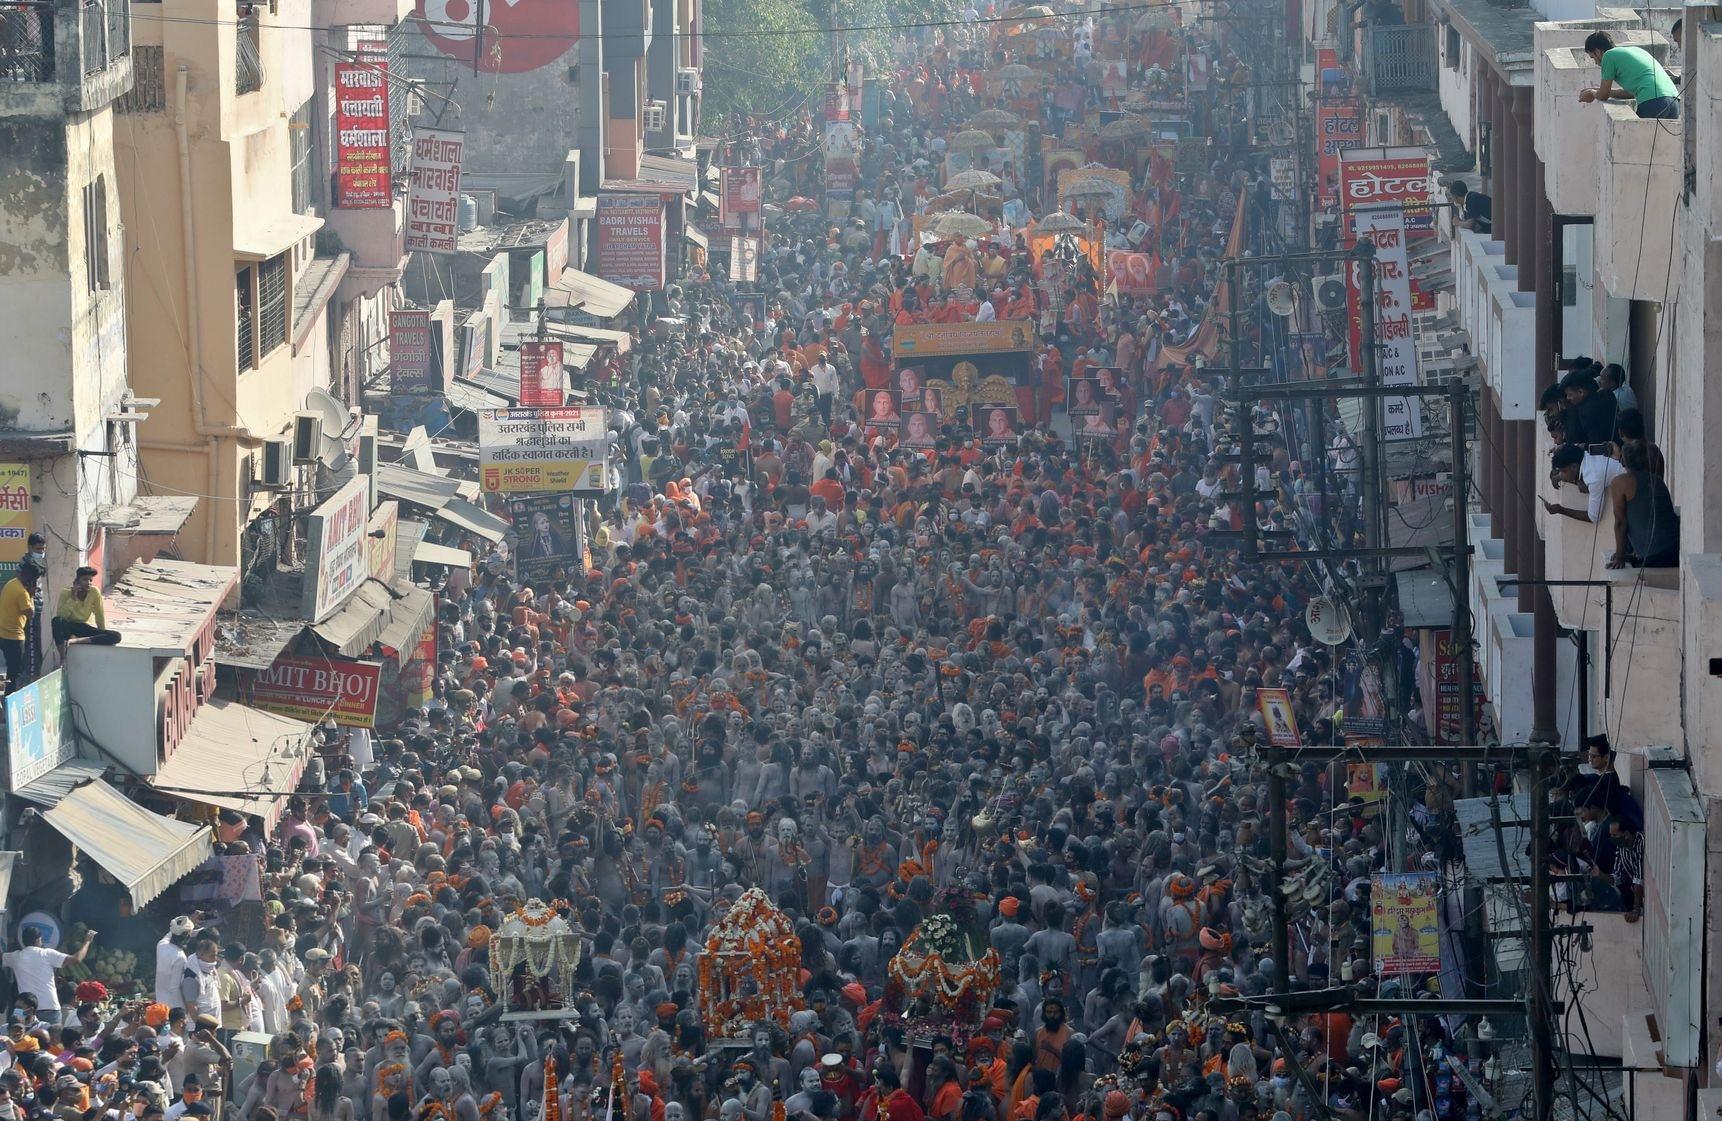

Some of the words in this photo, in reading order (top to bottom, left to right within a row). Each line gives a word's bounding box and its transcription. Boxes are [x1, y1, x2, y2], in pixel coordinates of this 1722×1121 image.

[340, 95, 384, 118] पंचायती
[340, 125, 387, 147] धर्मशाला
[416, 134, 462, 163] धर्मशाला
[412, 165, 459, 194] मारवाड़ी
[411, 195, 457, 221] पंचायती
[600, 217, 625, 225] BADRI
[628, 216, 659, 225] VISHAL
[611, 227, 649, 236] TRAVELS
[408, 234, 427, 249] काली
[430, 236, 454, 251] कमली
[392, 314, 427, 328] GANGOTRI
[395, 332, 424, 346] TRAVELS
[498, 421, 536, 434] उत्तराखंड
[538, 420, 565, 435] पुलिस
[567, 420, 586, 432] सभी
[516, 434, 556, 448] श्रद्धालुओं
[558, 436, 571, 446] का
[492, 449, 520, 460] हार्दिक
[522, 451, 553, 460] स्वागत
[555, 447, 579, 459] करती
[503, 475, 540, 483] STRONG
[313, 669, 373, 702] BHOJ
[303, 695, 326, 705] LUNCH
